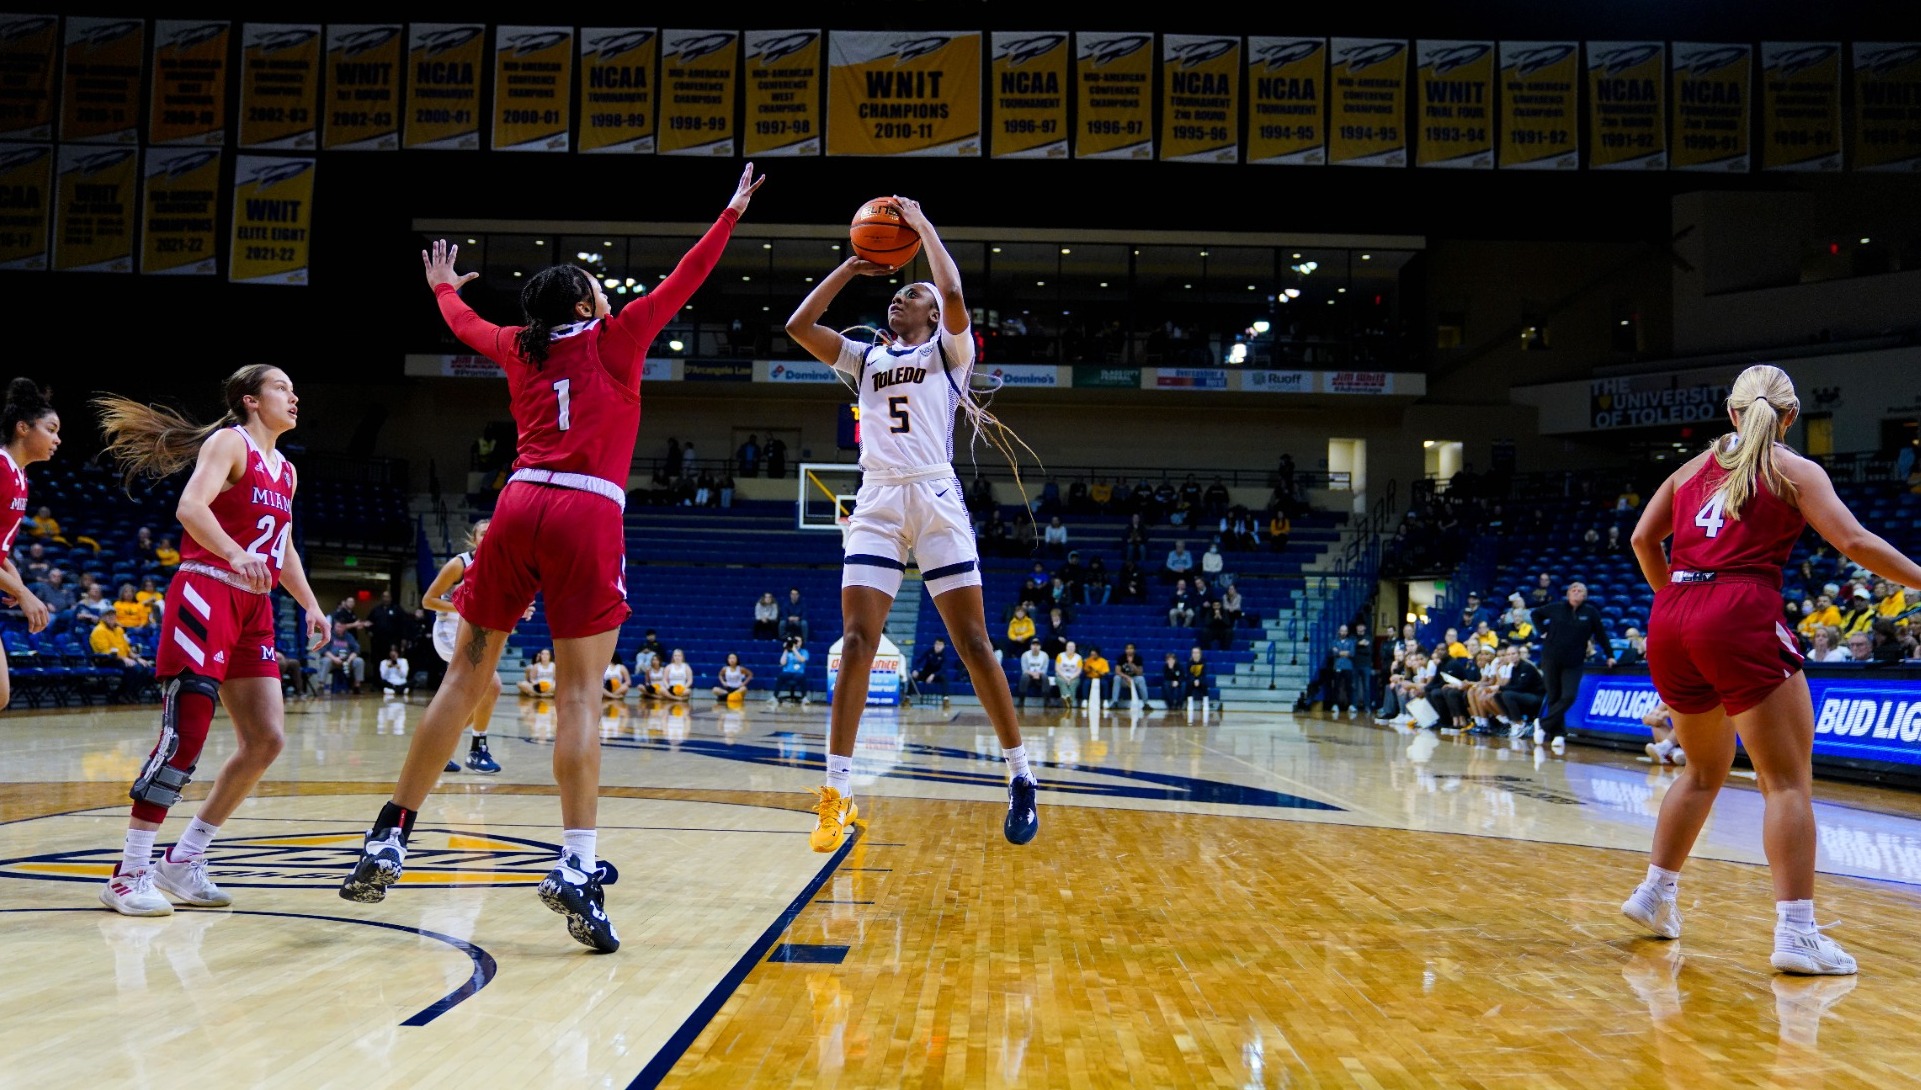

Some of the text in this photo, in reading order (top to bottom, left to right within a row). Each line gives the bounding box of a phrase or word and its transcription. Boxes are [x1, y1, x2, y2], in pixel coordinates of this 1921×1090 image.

[336, 62, 392, 84] WNIT
[417, 62, 473, 84] NCAA
[590, 67, 646, 88] NCAA
[865, 71, 944, 98] WNIT
[1001, 72, 1059, 94] NCAA
[1089, 86, 1140, 95] CONFERENCE
[1172, 72, 1230, 95] NCAA
[1257, 78, 1315, 100] NCAA
[1597, 79, 1656, 101] NCAA
[1681, 80, 1740, 103] NCAA
[1425, 81, 1485, 103] WNIT
[1171, 96, 1231, 108] TOURNAMENT
[416, 109, 471, 124] 2000-01
[503, 110, 560, 124] 2000-01
[859, 103, 949, 119] CHAMPIONS
[591, 114, 644, 127] 1998-99
[669, 117, 726, 130] 1998-99
[755, 120, 810, 134] 1997-98
[1004, 120, 1057, 133] 1996-97
[1087, 121, 1143, 135] 1996-97
[874, 123, 933, 139] 2010-11
[1172, 126, 1227, 140] 1995-96
[1260, 126, 1314, 140] 1994-95
[1340, 127, 1397, 141] 1994-95
[1426, 128, 1485, 142] 1993-94
[246, 200, 301, 222] WNIT
[245, 247, 296, 261] 2021-22
[785, 370, 836, 380] Domino's
[872, 366, 927, 392] TOLEDO
[1004, 374, 1054, 384] Domino's
[1268, 373, 1301, 383] Ruoff
[1591, 379, 1631, 396] THE
[553, 378, 570, 431] 1
[888, 396, 910, 434] 5
[1595, 402, 1716, 429] OF TOLEDO
[252, 487, 291, 513] MIAM
[246, 514, 291, 570] 24
[1590, 689, 1662, 719] BUD LIGH
[1815, 698, 1921, 742] BUD LIG
